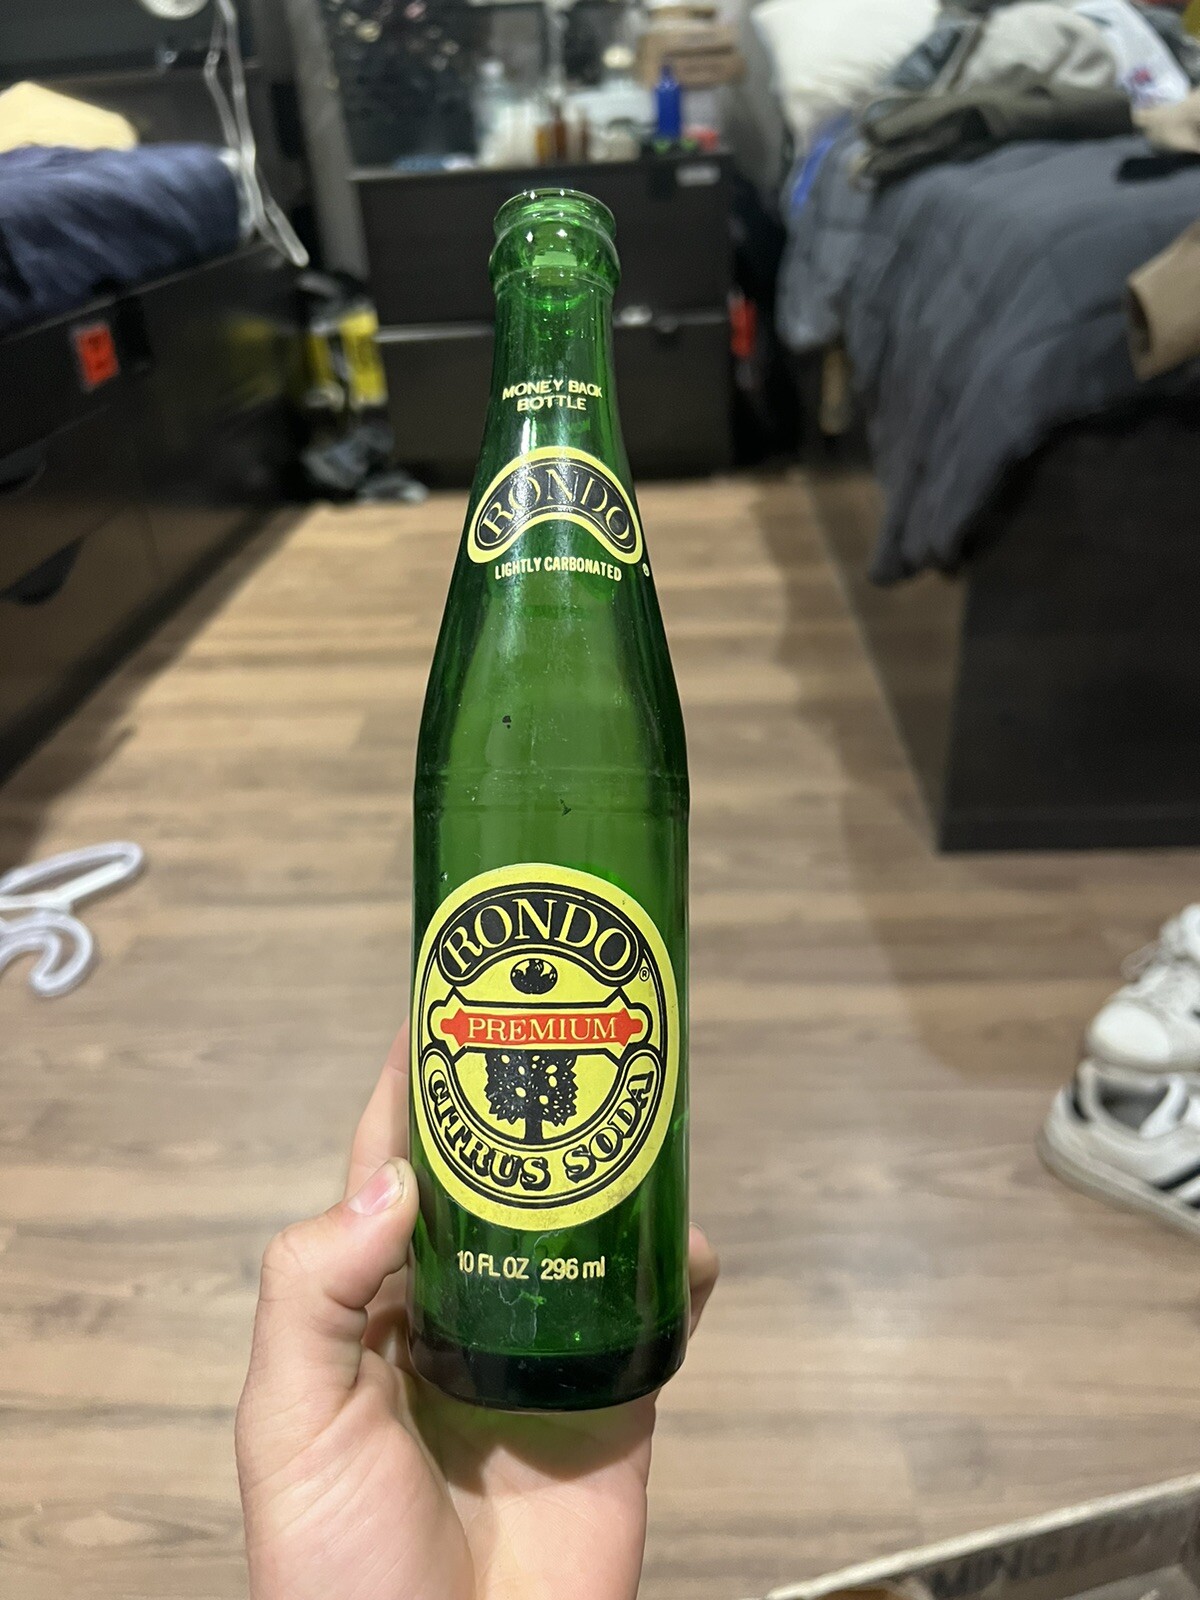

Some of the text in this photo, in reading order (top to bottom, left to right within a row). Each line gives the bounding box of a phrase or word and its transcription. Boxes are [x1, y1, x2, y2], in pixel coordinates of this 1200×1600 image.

[502, 379, 603, 400] MONEY BACK
[517, 395, 587, 412] BOTTLE
[480, 468, 630, 540] RONDO
[495, 556, 622, 581] LIGHTLY CARBONATED
[443, 898, 632, 974] RONDO
[467, 1016, 617, 1042] PREMIUM
[428, 1069, 655, 1191] CITRUS SODA
[456, 1250, 606, 1281] 10 FL OZ 296 ml
